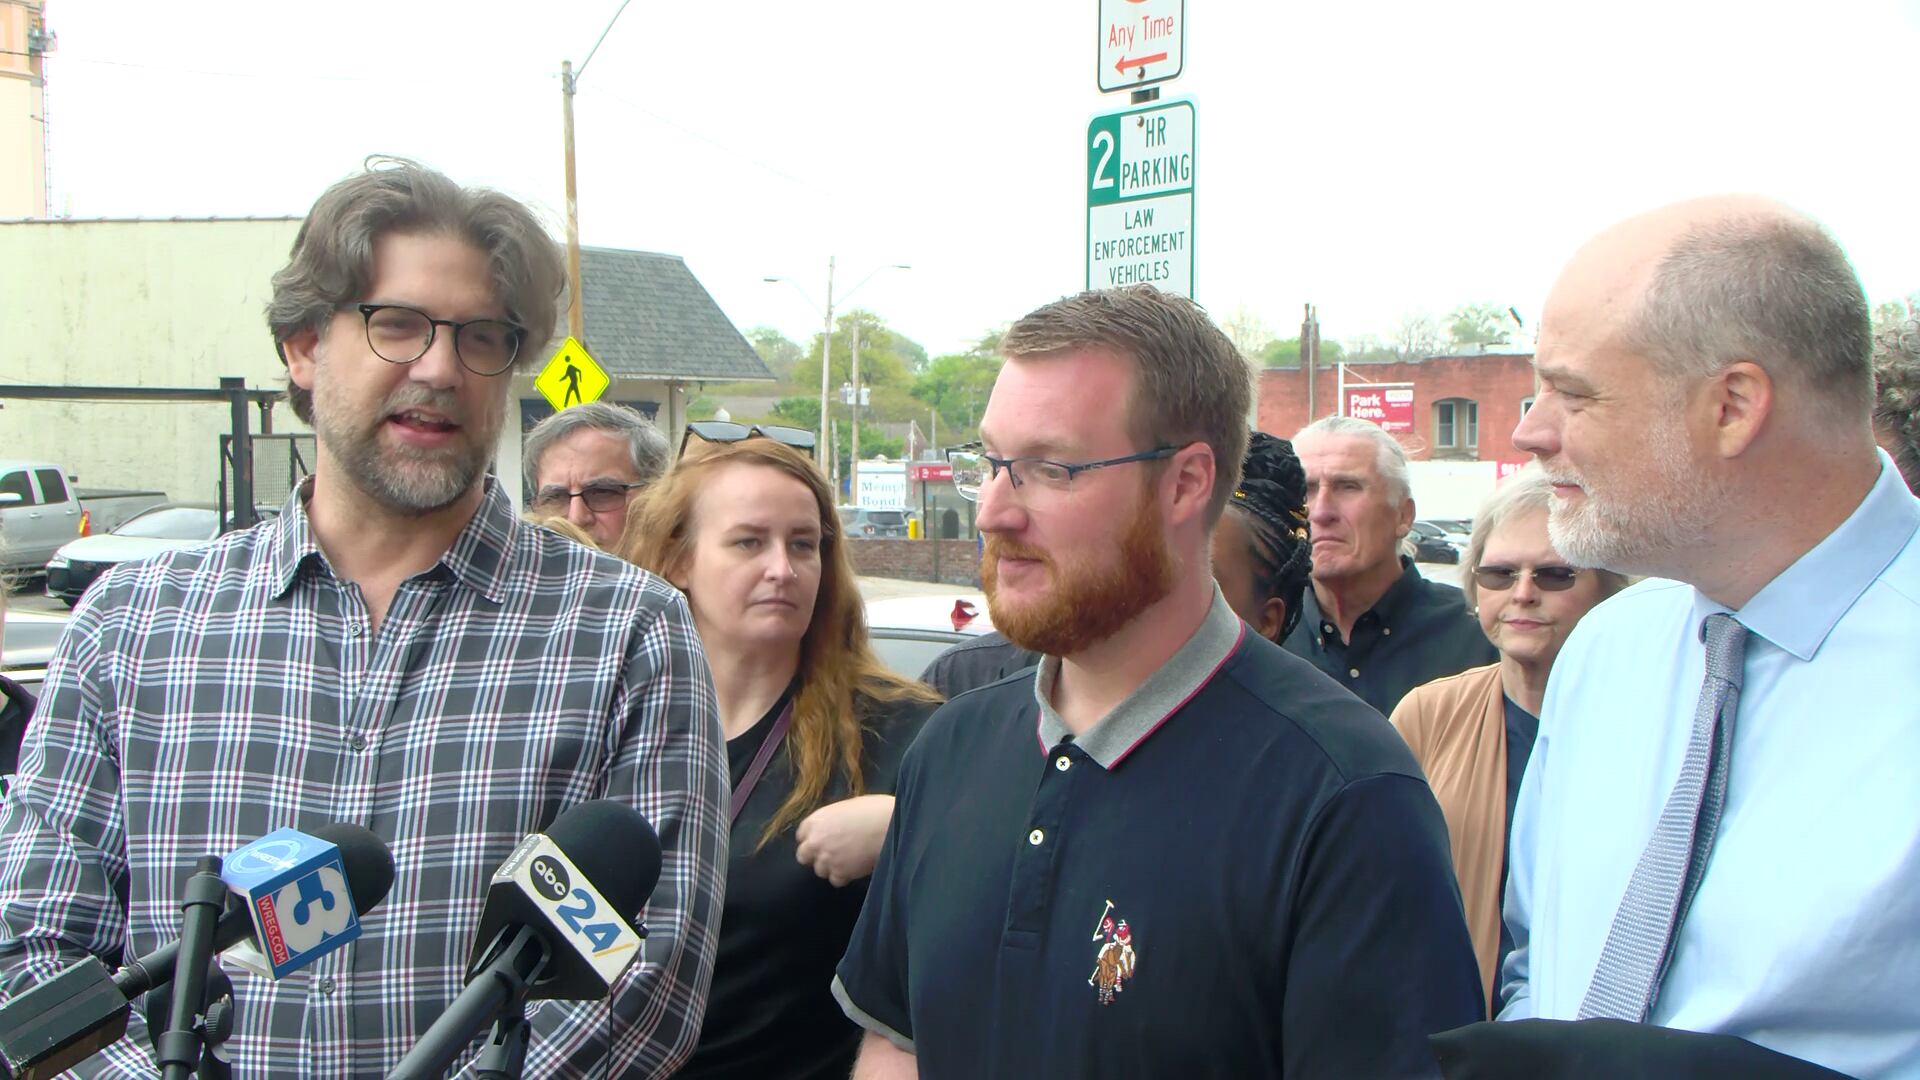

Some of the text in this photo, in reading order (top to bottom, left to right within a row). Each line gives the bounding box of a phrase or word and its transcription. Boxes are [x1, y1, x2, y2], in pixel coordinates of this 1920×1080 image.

[1108, 15, 1174, 51] Any Time
[1145, 116, 1167, 147] HR
[1092, 129, 1115, 190] 2
[1121, 153, 1190, 190] PARKING
[1124, 208, 1154, 230] LAW
[1094, 231, 1185, 261] ENFORCEMENT
[1109, 260, 1170, 285] VEHICLES
[1350, 394, 1381, 407] Park
[1350, 406, 1386, 418] Here.
[276, 866, 352, 953] 3
[533, 859, 623, 953] abc 24
[258, 897, 288, 964] WREG.COM
